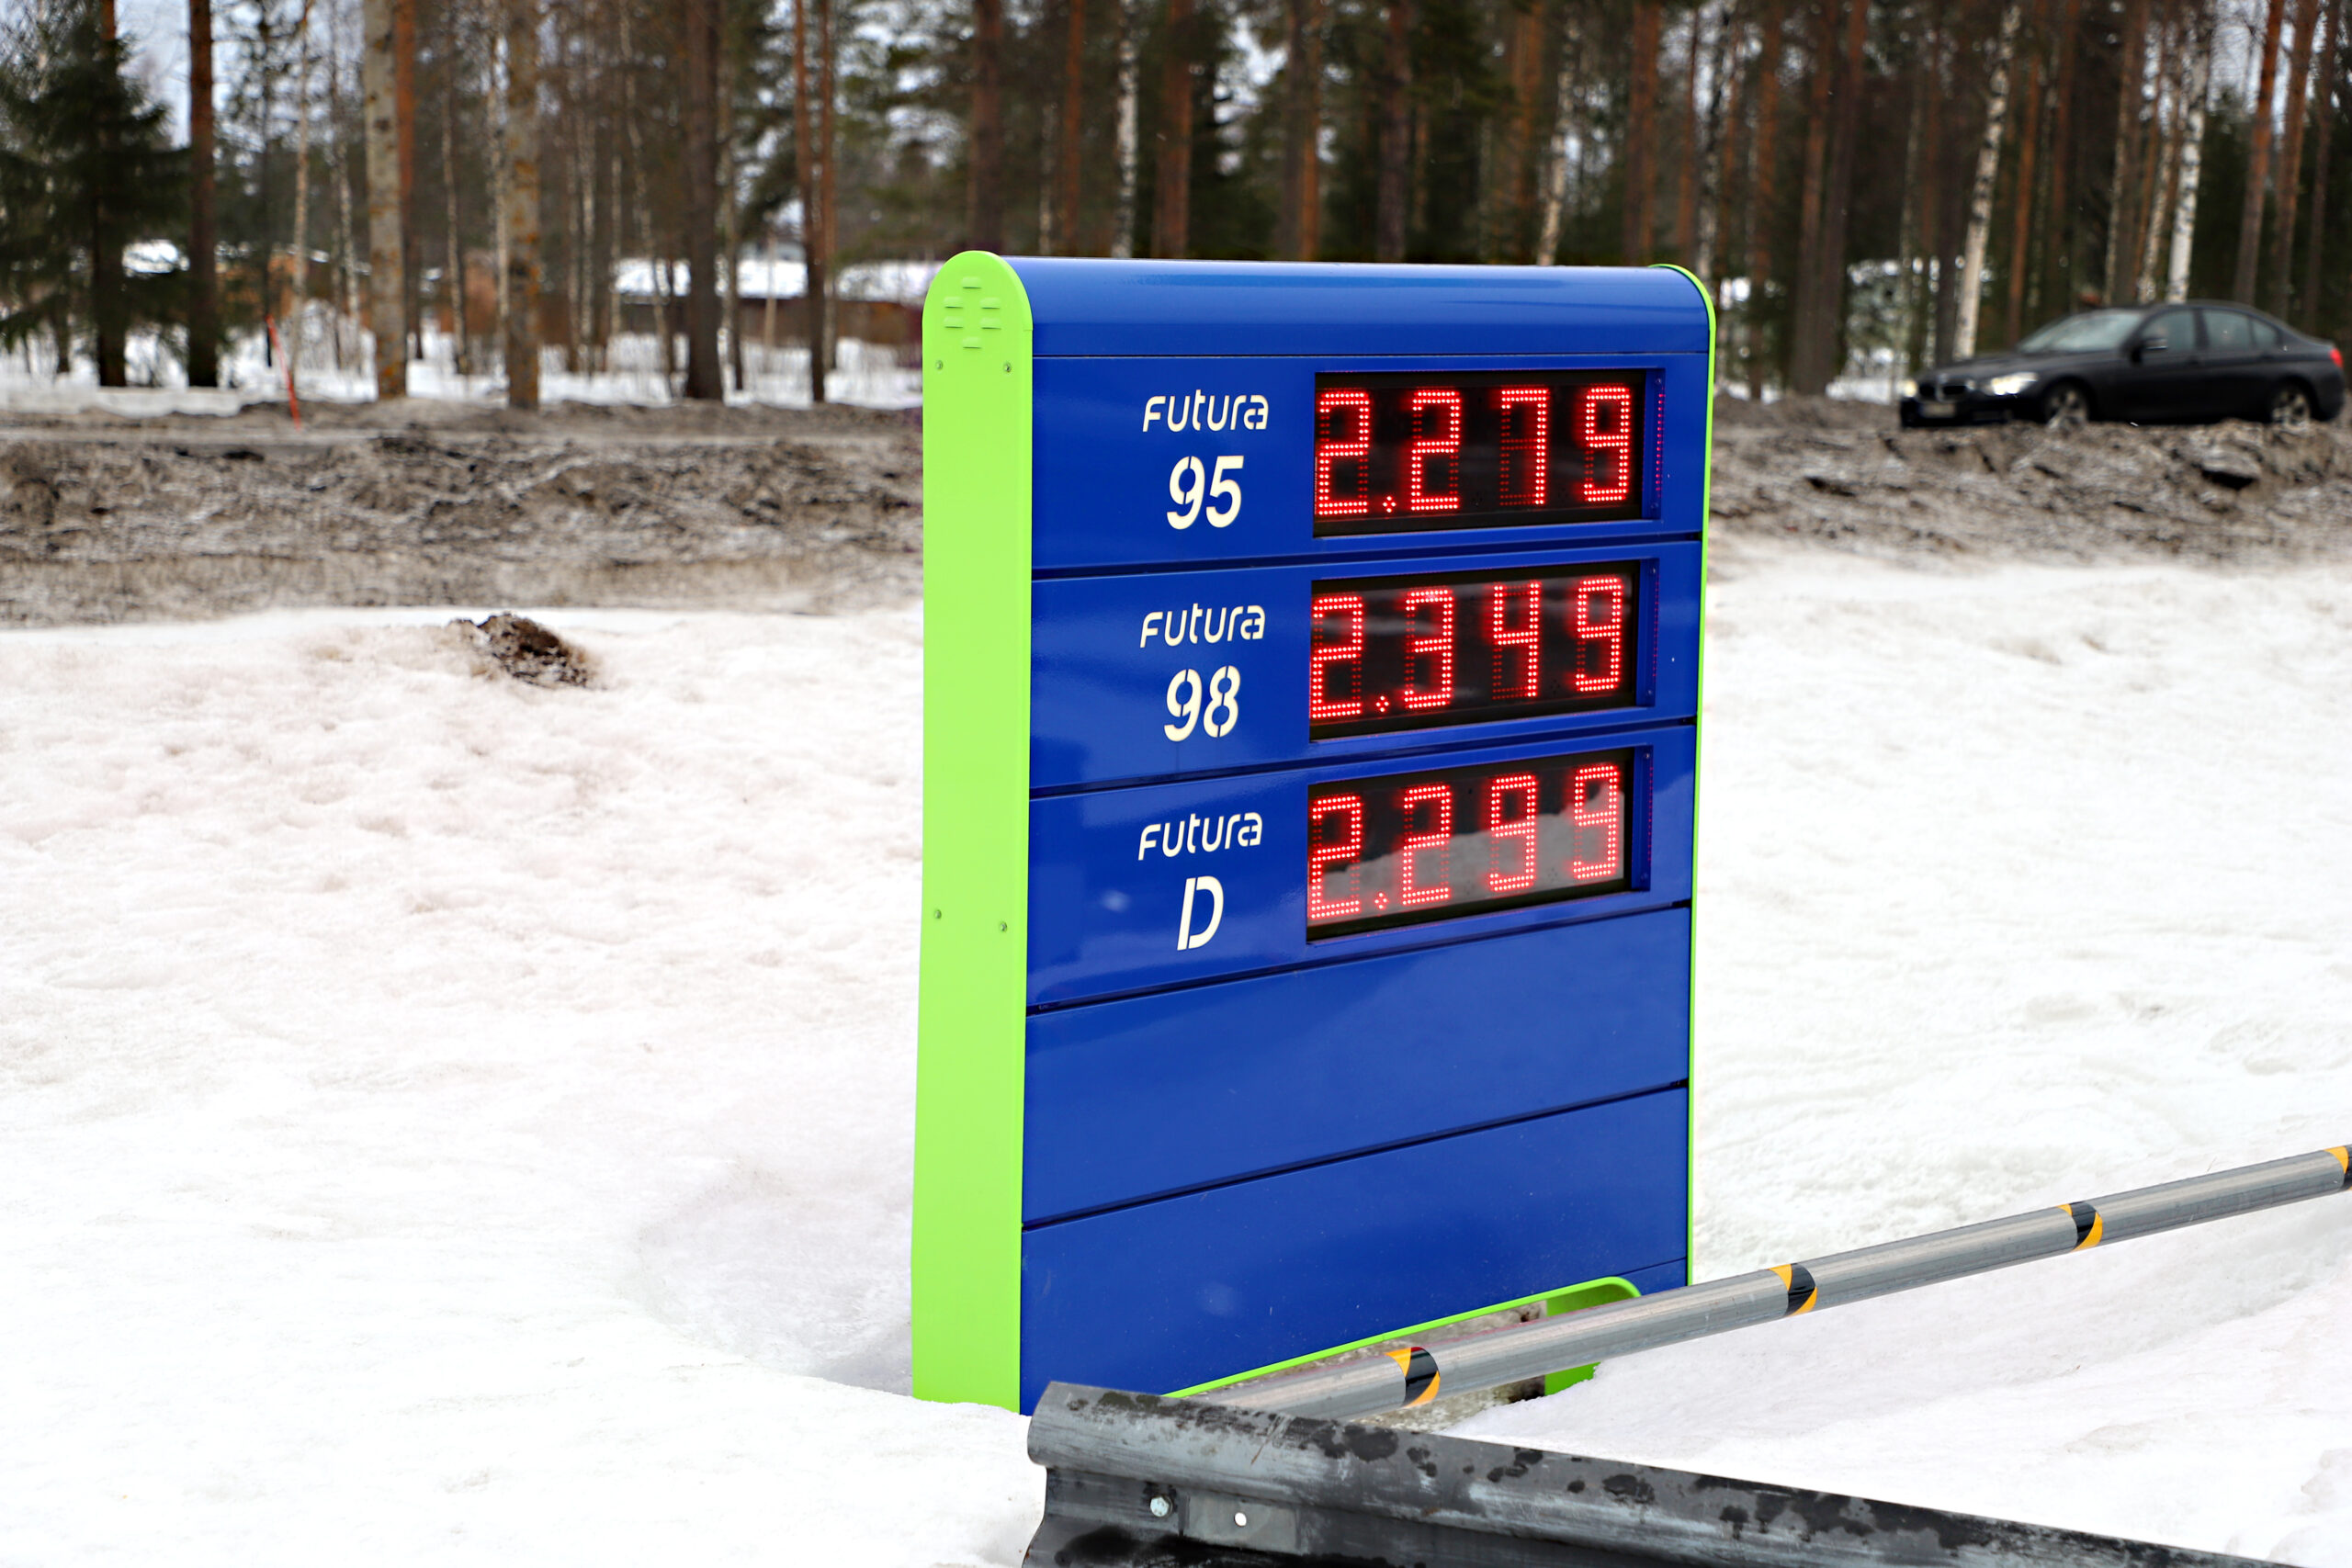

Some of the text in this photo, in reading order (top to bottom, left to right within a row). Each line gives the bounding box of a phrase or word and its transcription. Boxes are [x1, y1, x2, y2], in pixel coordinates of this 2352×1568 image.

[1142, 389, 1269, 433] Futura
[1316, 386, 1631, 515] 2.279
[1166, 455, 1244, 530] 95
[1139, 603, 1266, 649] Futura
[1311, 577, 1624, 719] 2.349
[1163, 665, 1241, 742] 98
[1137, 812, 1263, 861] Futura
[1308, 764, 1621, 920] 2.299
[1177, 875, 1224, 951] D
